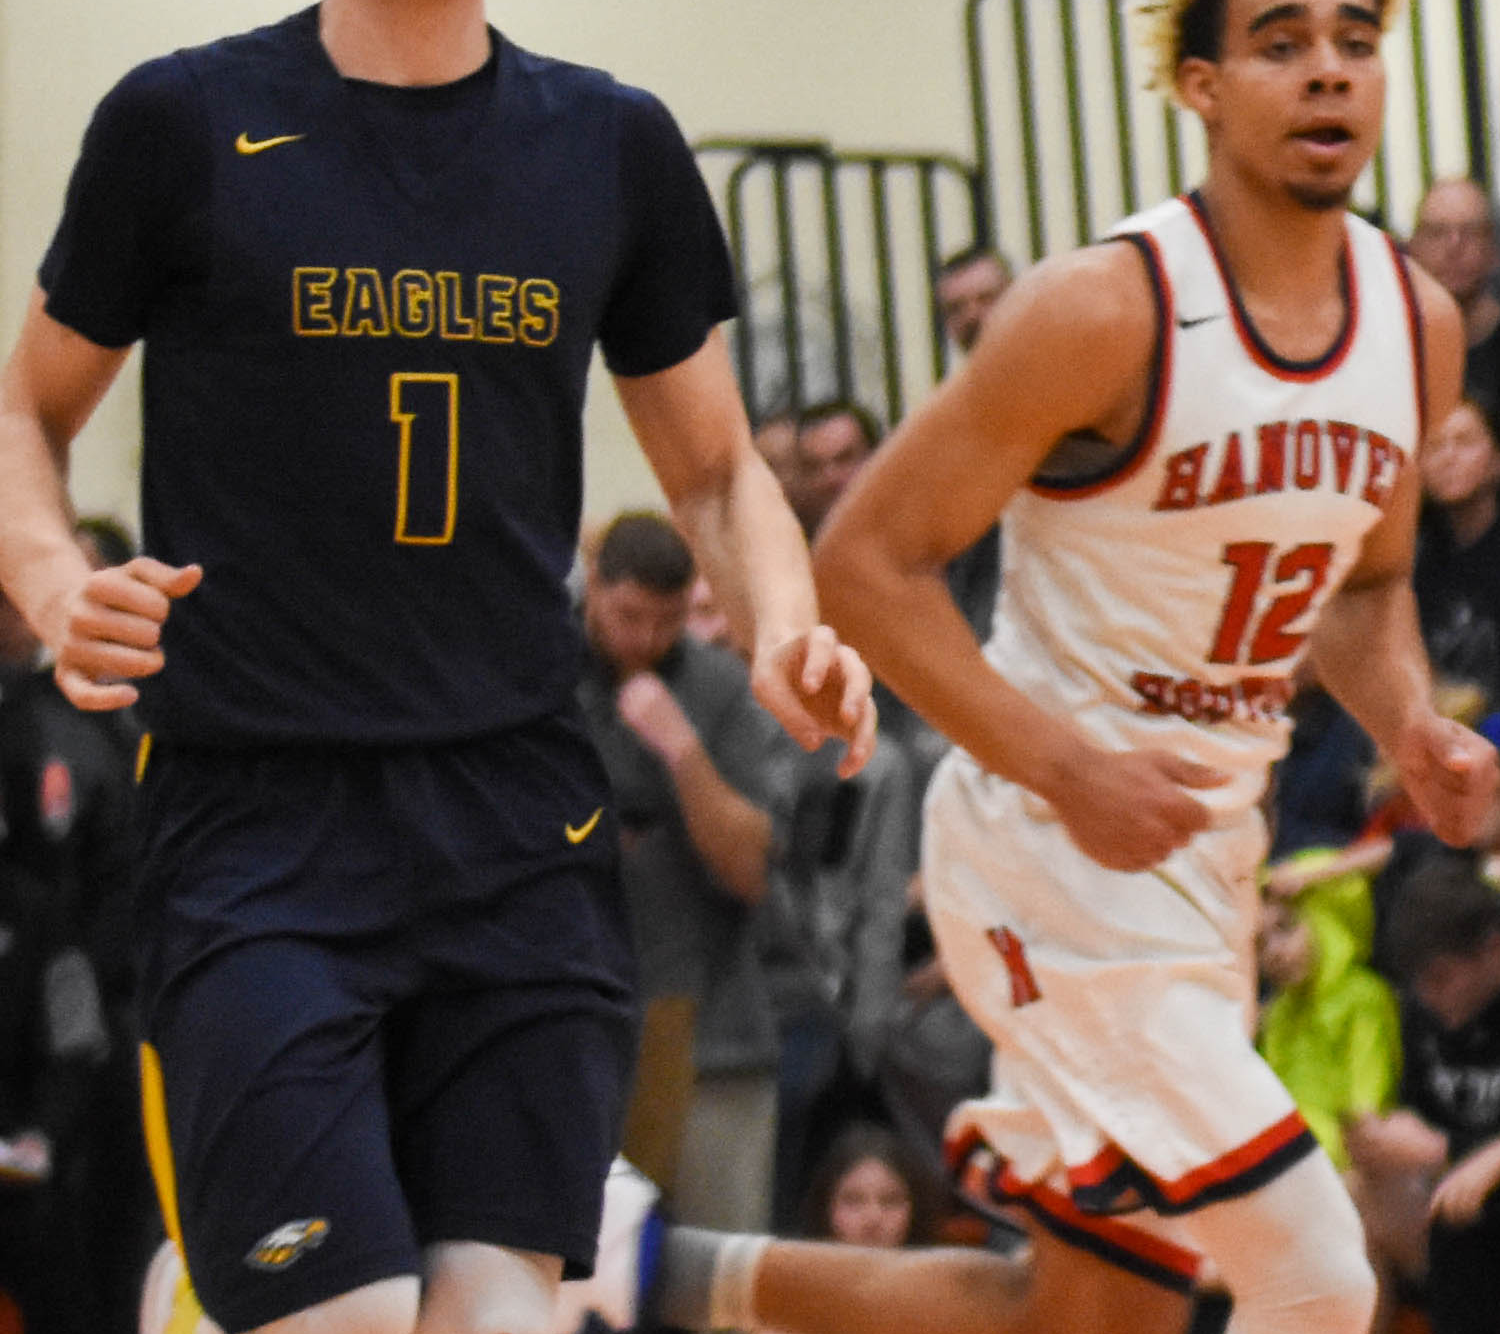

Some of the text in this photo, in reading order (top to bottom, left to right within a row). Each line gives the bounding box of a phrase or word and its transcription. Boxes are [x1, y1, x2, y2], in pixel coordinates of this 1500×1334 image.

[293, 267, 560, 347] EAGLES
[390, 372, 459, 545] 1
[1152, 420, 1405, 511] HANOVE
[1208, 541, 1335, 666] 12
